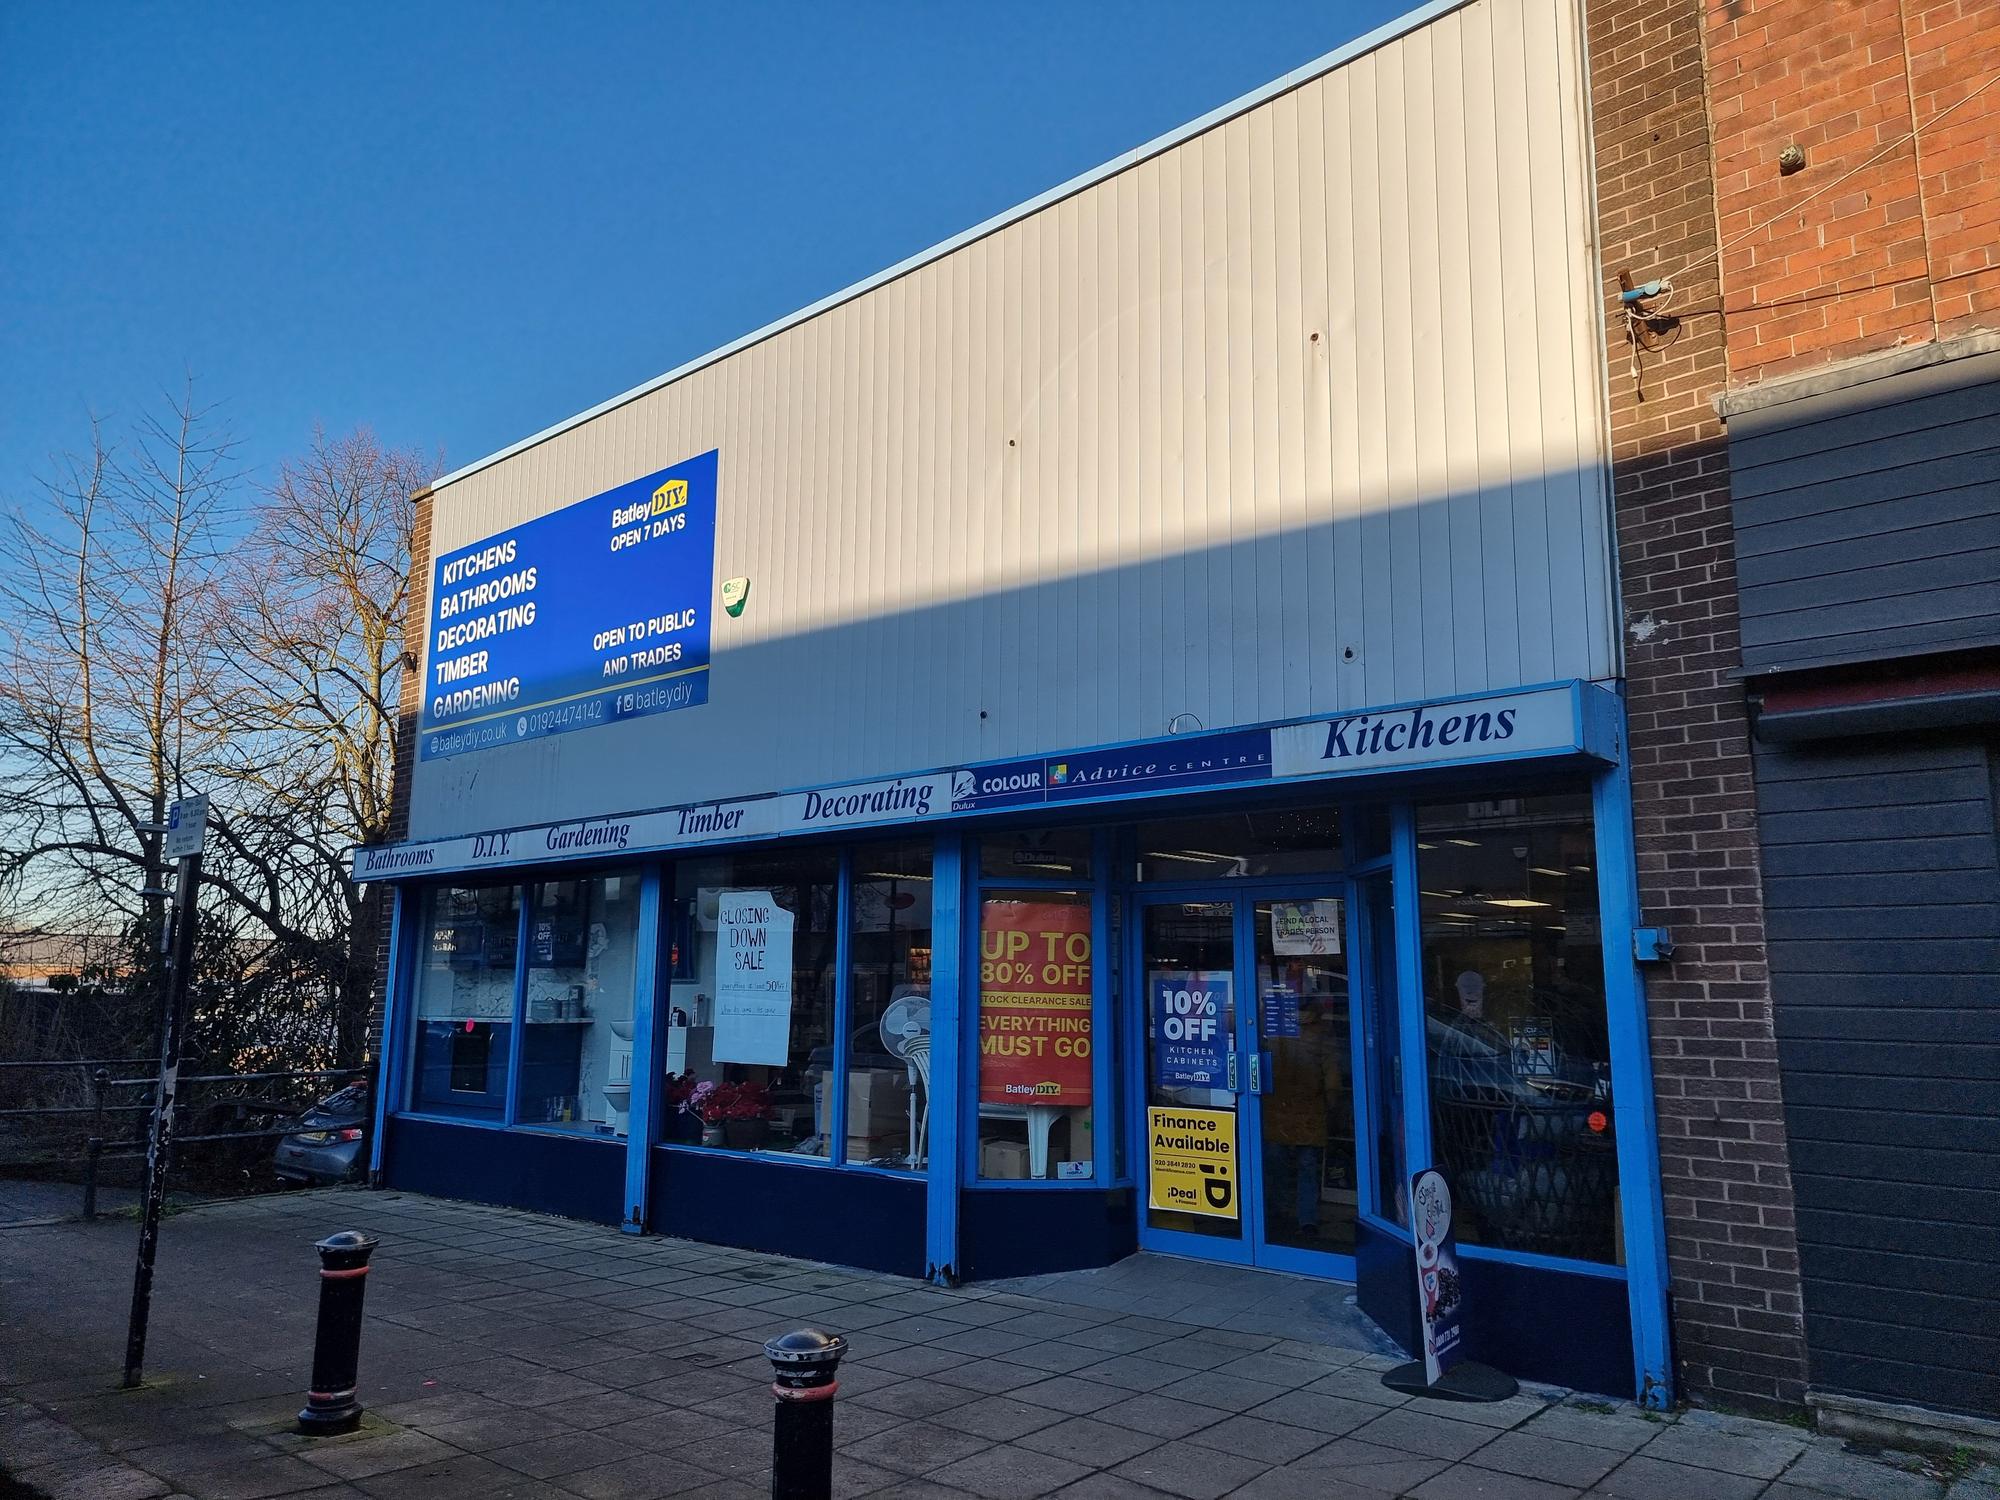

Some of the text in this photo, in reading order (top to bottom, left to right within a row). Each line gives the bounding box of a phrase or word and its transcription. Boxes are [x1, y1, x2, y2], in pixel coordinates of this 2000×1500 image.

[612, 501, 652, 529] Batley
[610, 513, 686, 552] OPEN 7 DAYS
[442, 539, 517, 586] KITCHENS
[440, 567, 537, 620] BATHROOMS
[437, 602, 536, 652] DECORATING
[593, 608, 696, 651] OPEN TO PUBLIC
[436, 650, 489, 685] TIMBER
[603, 643, 682, 678] AND TRADES
[433, 677, 520, 719] GARDENING
[636, 681, 693, 710] batleydiy
[529, 700, 602, 732] 01924474142
[439, 722, 507, 752] batleydiy.co.uk
[1320, 707, 1516, 759] Kitchens
[982, 772, 1041, 793] COLOUR
[1072, 762, 1157, 783] Advice
[1169, 753, 1265, 771] CENTRE
[952, 801, 976, 811] Dulux
[365, 780, 934, 871] Bathrooms D.I.Y. Gardening Timber Decorating
[720, 907, 769, 924] CLOSING
[1304, 915, 1329, 924] LOCAL
[730, 928, 766, 947] DOWN
[1305, 926, 1335, 935] PERSON
[981, 930, 1091, 963] UP TO
[735, 950, 765, 970] SALE
[981, 962, 1091, 986] 80% OFF
[980, 995, 1091, 1006] TOCK CLEARANCE SALE
[1163, 990, 1217, 1016] 10%
[1164, 1017, 1217, 1041] OFF
[1054, 1037, 1091, 1058] GO
[1169, 1046, 1214, 1055] KITCHEN
[1166, 1057, 1217, 1066] CABINETS
[1175, 1072, 1193, 1081] Batley
[1006, 1084, 1035, 1095] Batley
[1153, 1113, 1217, 1131] Finance
[1154, 1134, 1230, 1153] Available
[1167, 1187, 1197, 1199] iDeal
